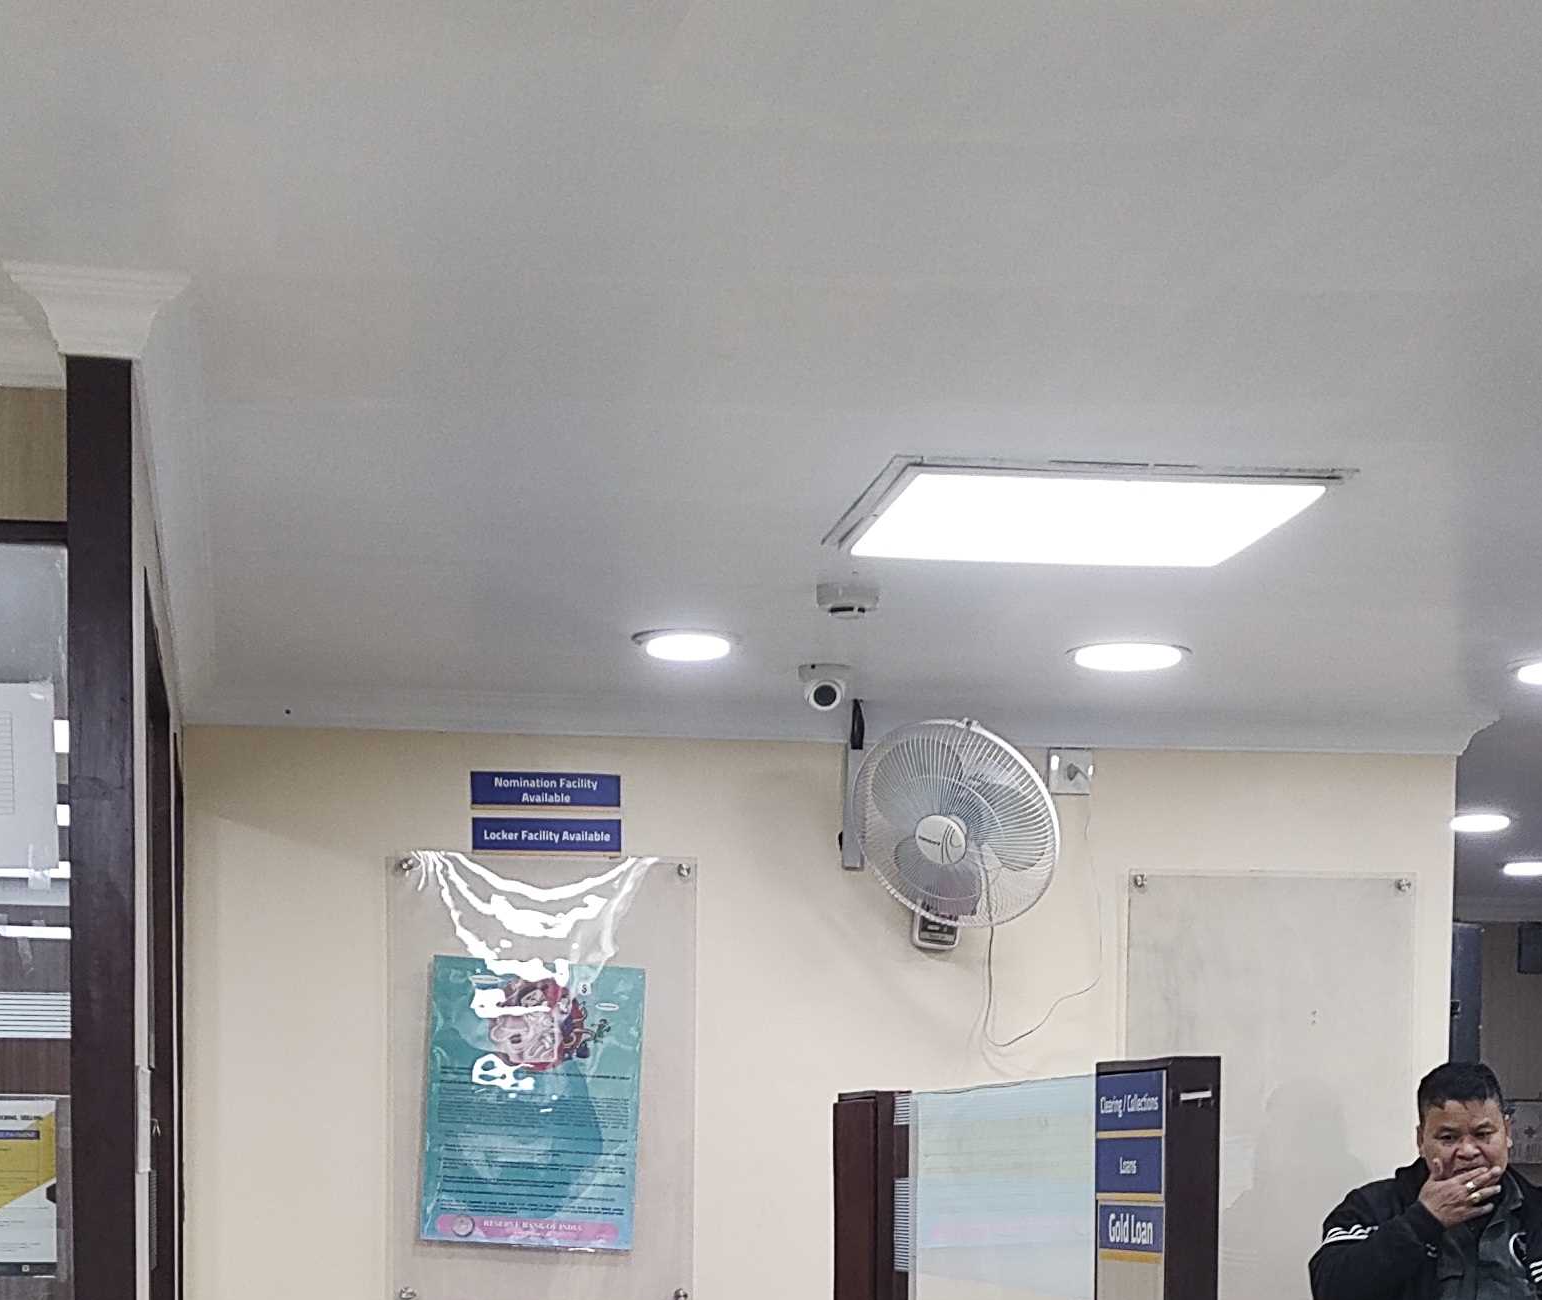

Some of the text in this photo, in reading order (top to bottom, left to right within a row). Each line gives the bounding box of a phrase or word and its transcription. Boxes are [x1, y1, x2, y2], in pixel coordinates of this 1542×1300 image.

[494, 777, 598, 790] Nomination Facility
[521, 793, 571, 803] Available
[484, 830, 611, 844] Locker Facility Available
[1100, 1096, 1123, 1118] Clearing
[1127, 1093, 1159, 1112] Collections
[1119, 1157, 1137, 1175] Loans
[1109, 1213, 1153, 1245] Gold Loan
